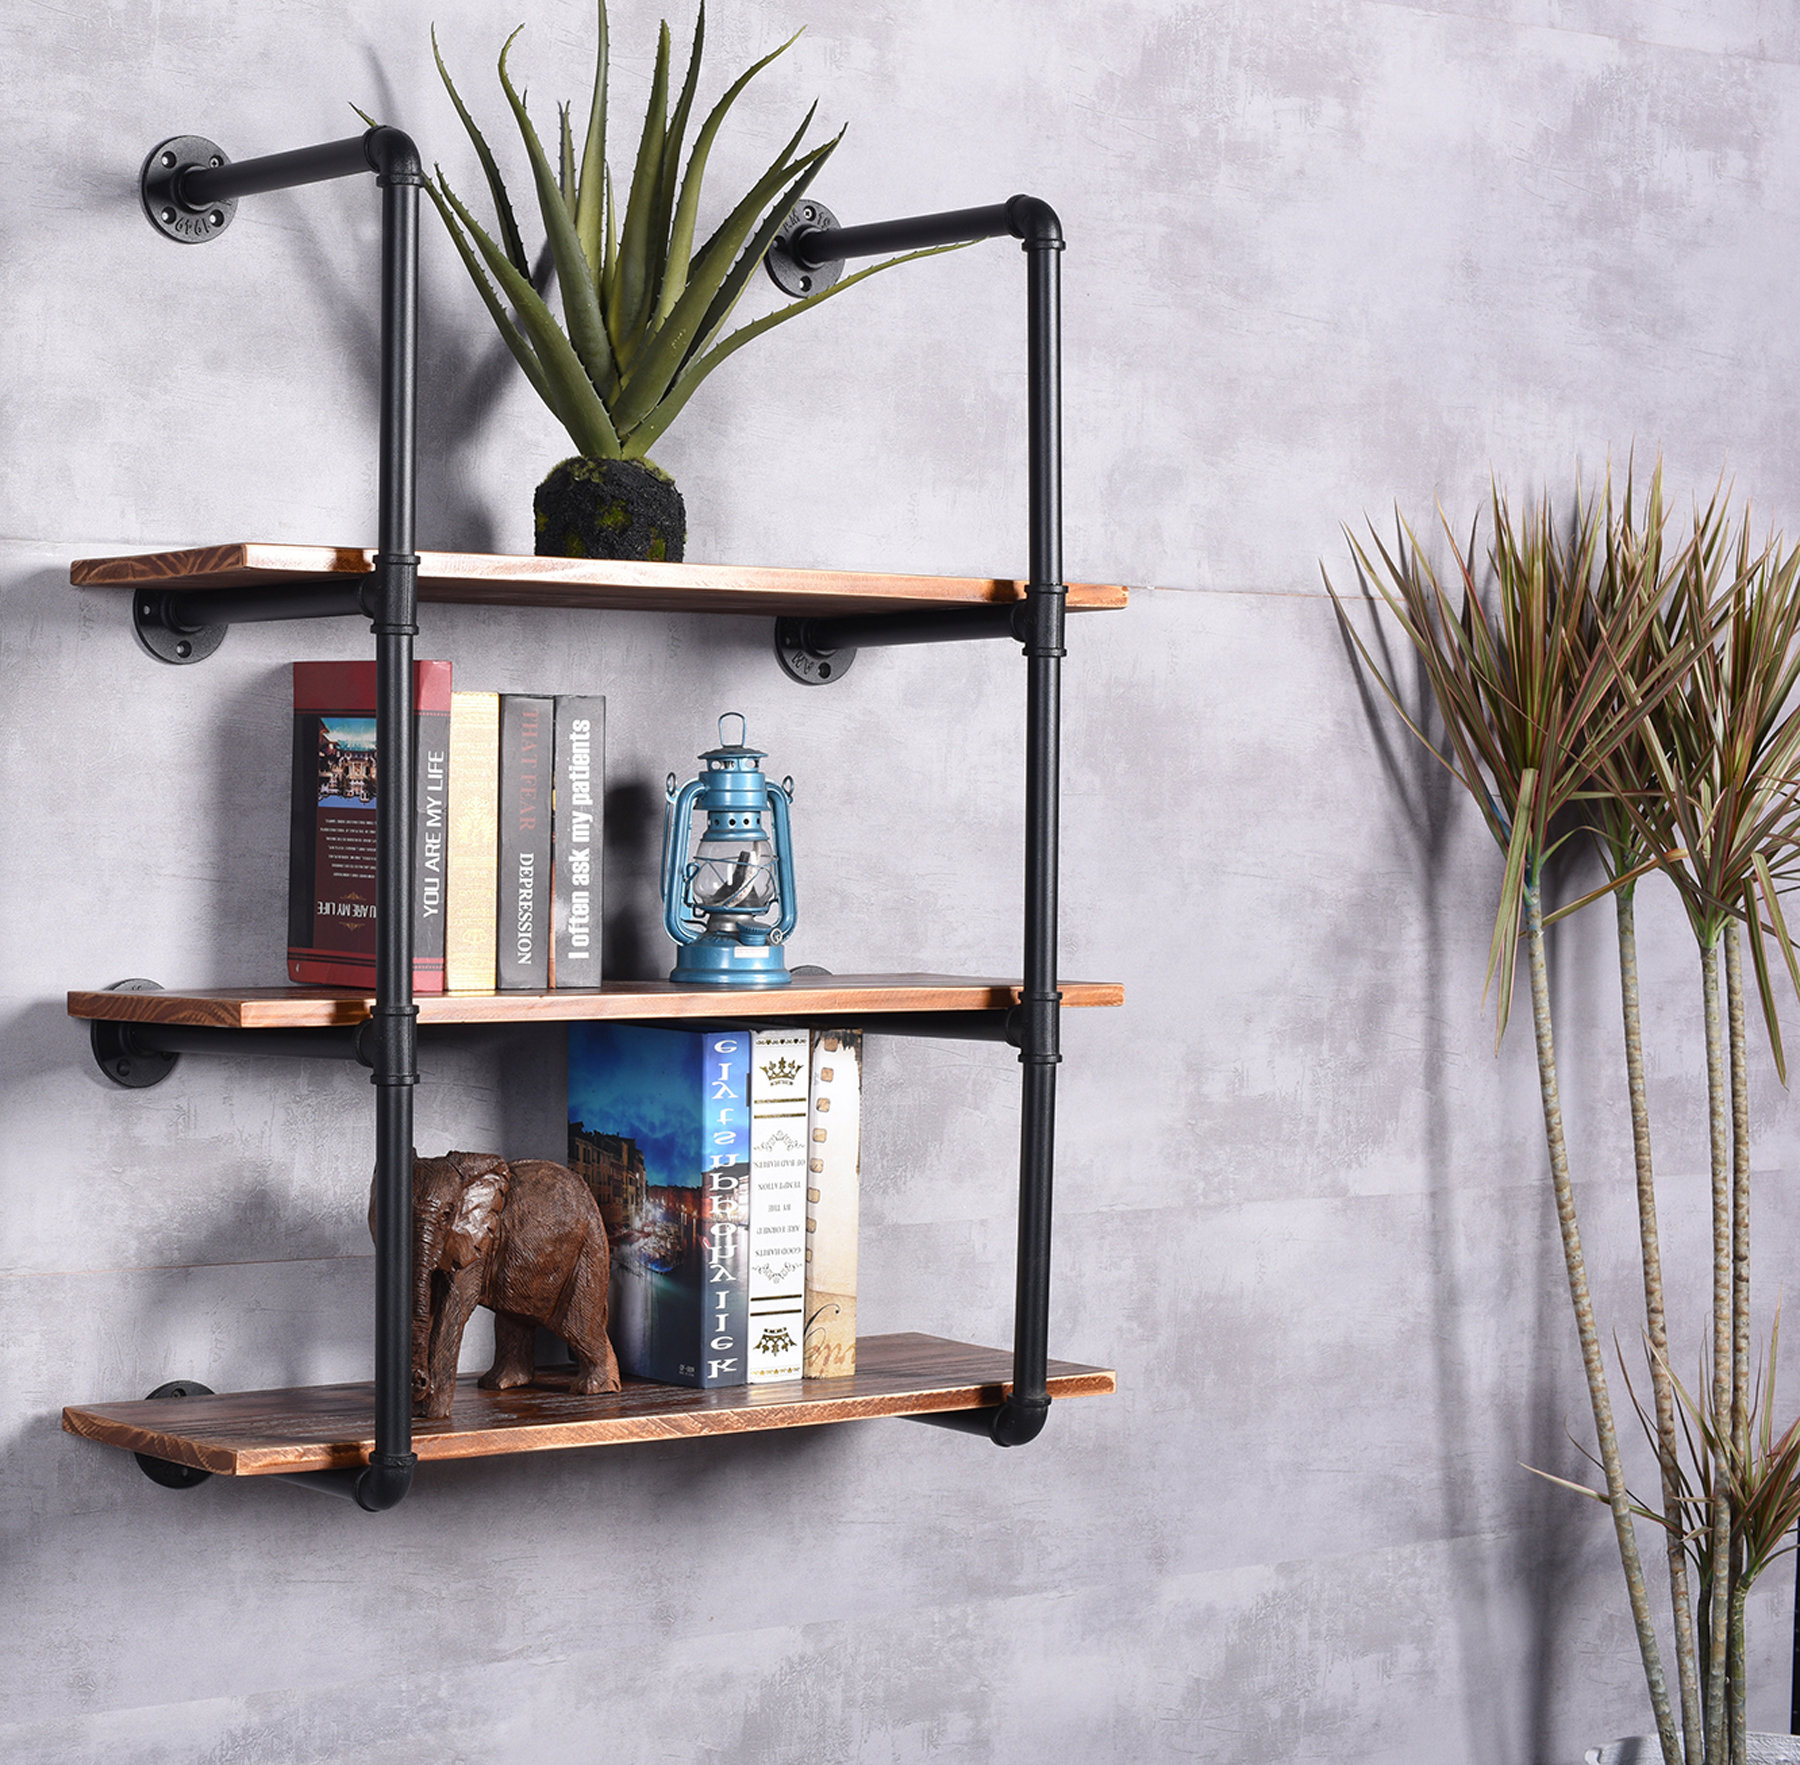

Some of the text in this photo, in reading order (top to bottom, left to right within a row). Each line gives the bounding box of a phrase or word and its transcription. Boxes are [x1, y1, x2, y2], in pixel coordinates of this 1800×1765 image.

[519, 709, 539, 832] THAT FEAR
[568, 719, 593, 806] patients
[423, 751, 445, 918] YOU ARE MY LIFE
[572, 810, 593, 842] my
[568, 848, 590, 886] ask
[317, 901, 336, 916] LIFE
[336, 903, 351, 917] MY
[517, 852, 534, 965] DEPRESSION
[568, 891, 590, 947] often
[780, 1159, 796, 1168] BAD
[758, 1181, 801, 1191] TEMPTATION
[787, 1224, 801, 1233] ARE
[755, 1246, 802, 1257] GOOD HABITS
